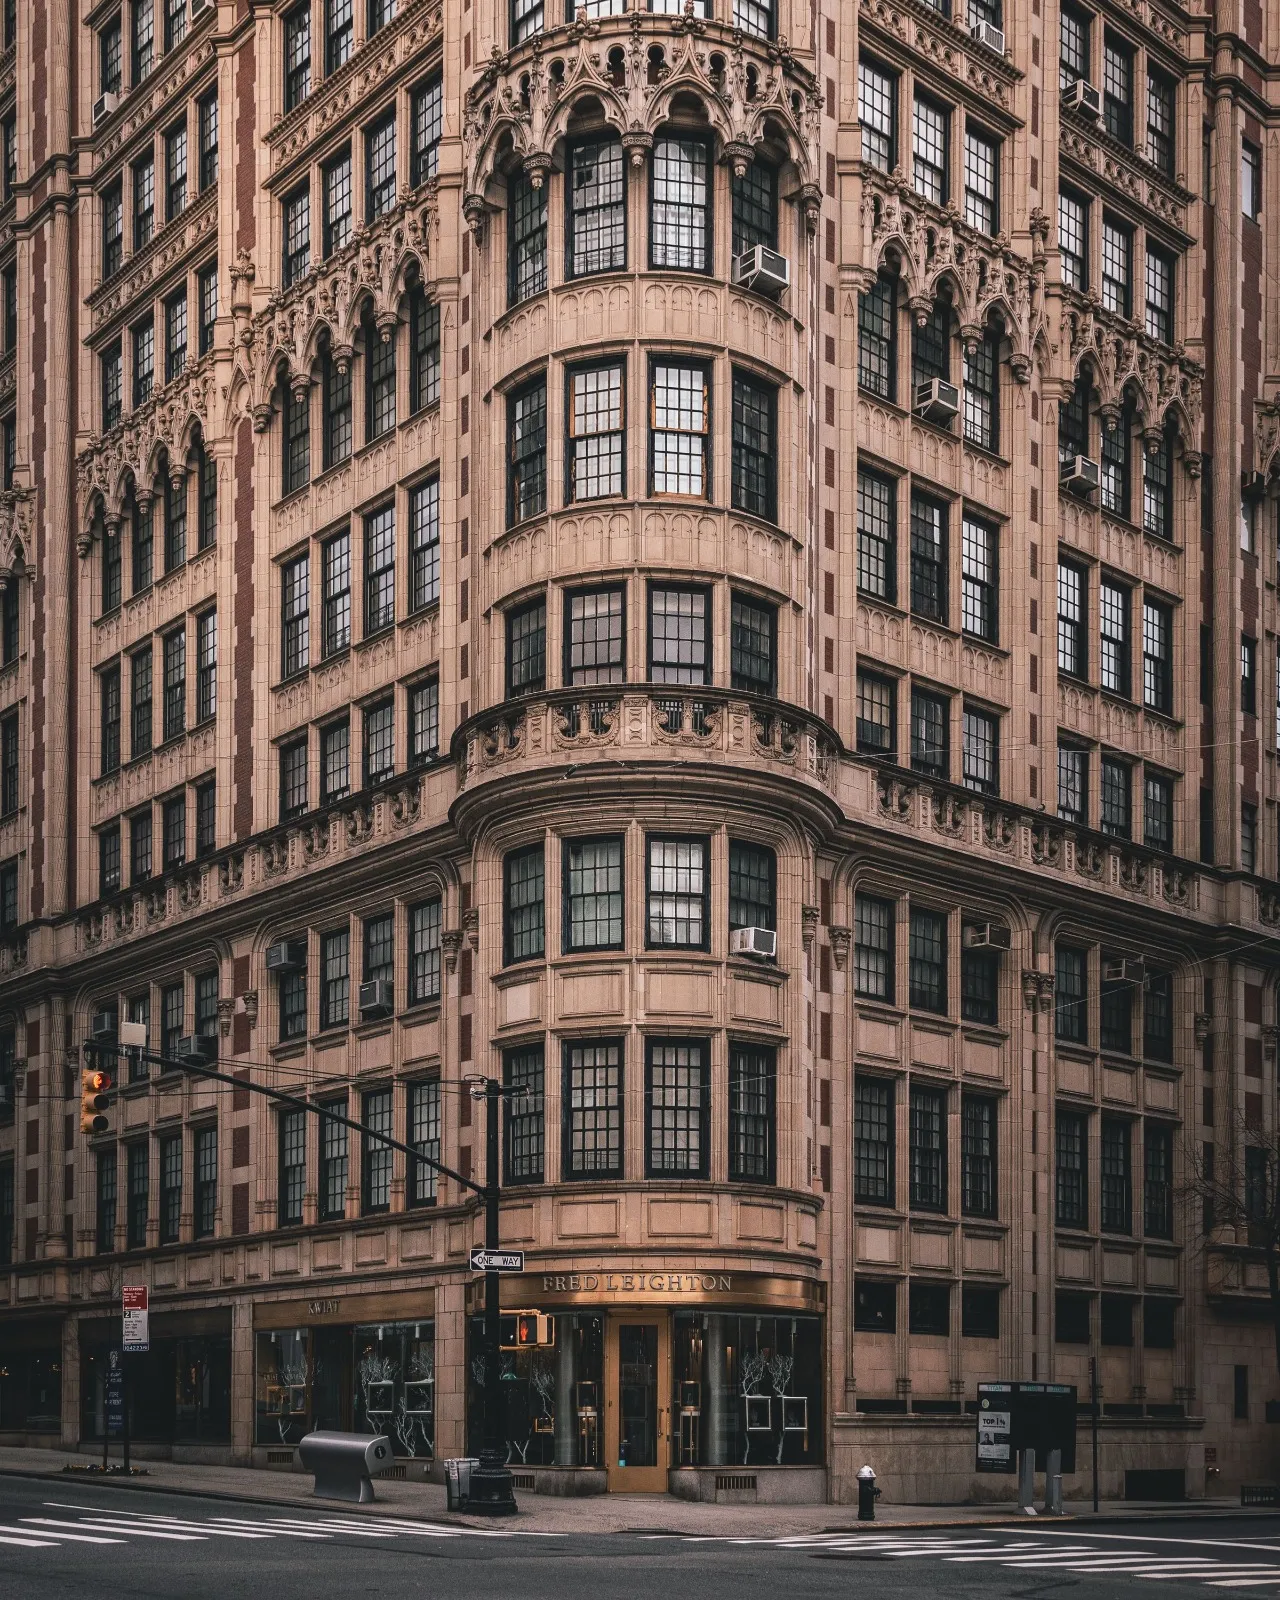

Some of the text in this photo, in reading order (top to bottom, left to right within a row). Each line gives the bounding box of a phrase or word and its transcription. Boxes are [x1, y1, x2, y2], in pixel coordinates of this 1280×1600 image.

[477, 1256, 518, 1265] ONE WAY
[542, 1275, 732, 1291] FRED LEIGHTON
[308, 1300, 340, 1314] KWIAT
